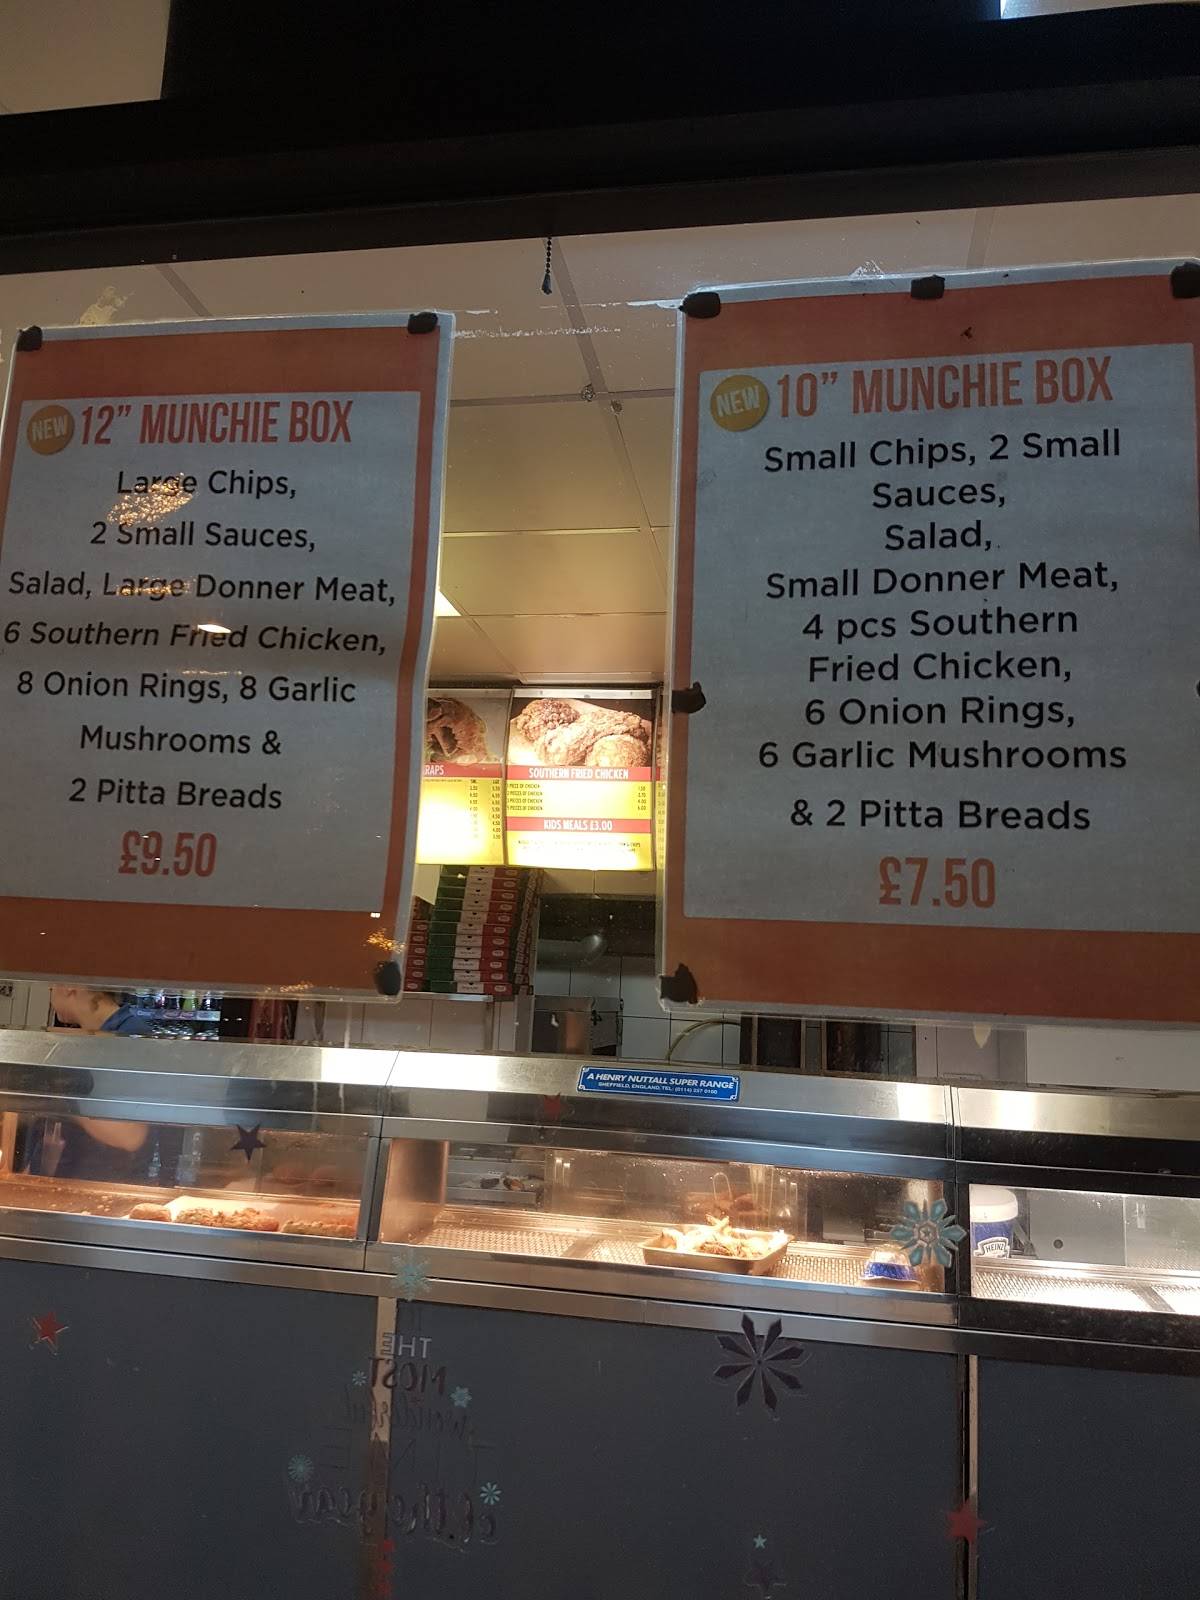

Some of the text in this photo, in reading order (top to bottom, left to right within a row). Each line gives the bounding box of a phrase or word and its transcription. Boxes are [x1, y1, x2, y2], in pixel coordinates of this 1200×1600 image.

[852, 361, 1023, 414] MUNCHIE
[1035, 357, 1113, 403] BOX
[716, 387, 760, 417] NEW
[32, 417, 67, 442] NEW
[140, 401, 279, 443] MUNCHIE
[289, 400, 353, 442] BOX
[765, 429, 1119, 472] Small Chips, 2 Small
[117, 470, 295, 499] Large Chips,
[873, 483, 1004, 508] Sauces,
[91, 521, 314, 552] 2 Small Sauces,
[885, 520, 991, 551] Salad,
[9, 571, 394, 606] Salad, Large Donner Meat,
[767, 562, 1117, 598] Small Donner Meat,
[5, 621, 385, 655] 6 Southern Fried Chicken,
[803, 607, 1077, 644] 4 pcs Southern
[810, 651, 1070, 682] Fried Chicken,
[18, 671, 355, 703] 8 Onion Rings, 8 Garlic
[806, 697, 1073, 728] 6 Onion Rings,
[81, 725, 280, 754] Mushrooms &
[760, 740, 1126, 768] 6 Garlic Mushrooms
[423, 765, 444, 776] RAPS
[529, 768, 629, 779] SOUTHERN FRIED CHICKEN
[69, 778, 281, 809] 2 Pitta Breads
[544, 820, 612, 831] KIDS MEALS £3.00
[791, 800, 1090, 829] & 2 Pitta Breads
[118, 831, 217, 877] £9.50
[880, 858, 995, 908] £7.50
[596, 1074, 627, 1082] HENRY
[628, 1075, 668, 1084] NUTTALL
[669, 1078, 699, 1086] SUPER
[699, 1080, 734, 1089] RANGE
[985, 1243, 1004, 1253] HEINZ
